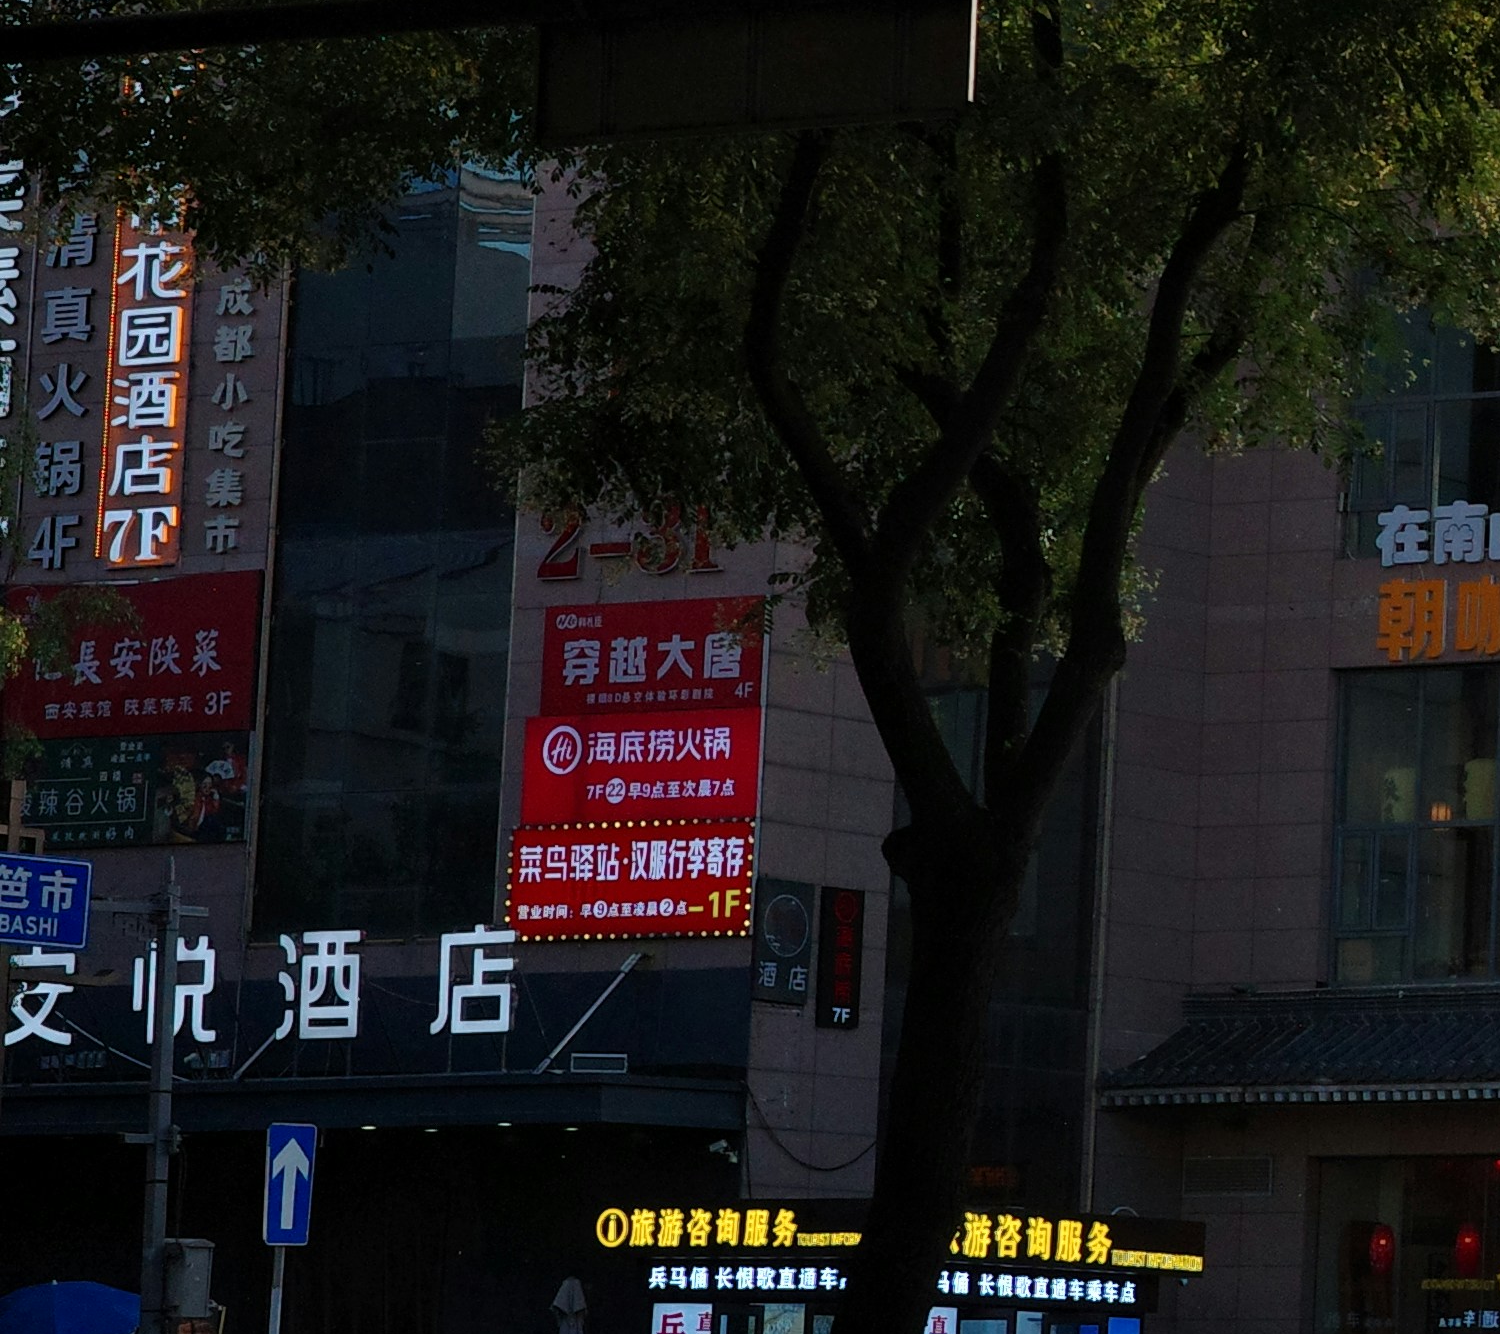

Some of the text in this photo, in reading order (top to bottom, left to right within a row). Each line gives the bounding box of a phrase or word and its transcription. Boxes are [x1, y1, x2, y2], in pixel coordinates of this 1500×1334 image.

[27, 149, 98, 570] 清真火锅4F
[103, 179, 190, 564] 花园酒店7F
[563, 634, 743, 686] 穿越大唐
[205, 691, 232, 716] 3F
[734, 682, 754, 699] 4F
[586, 727, 732, 765] 海底捞火锅
[4, 924, 517, 1047] 安悦酒店
[758, 960, 809, 992] 酒店
[831, 1006, 852, 1025] 7F
[629, 1208, 799, 1248] 旅游咨询服务
[949, 1212, 1112, 1266] 游咨询服务
[648, 1267, 848, 1291] 兵马俑 长恨歌直通车
[977, 1271, 1137, 1304] 长恨歌直通车乘车点
